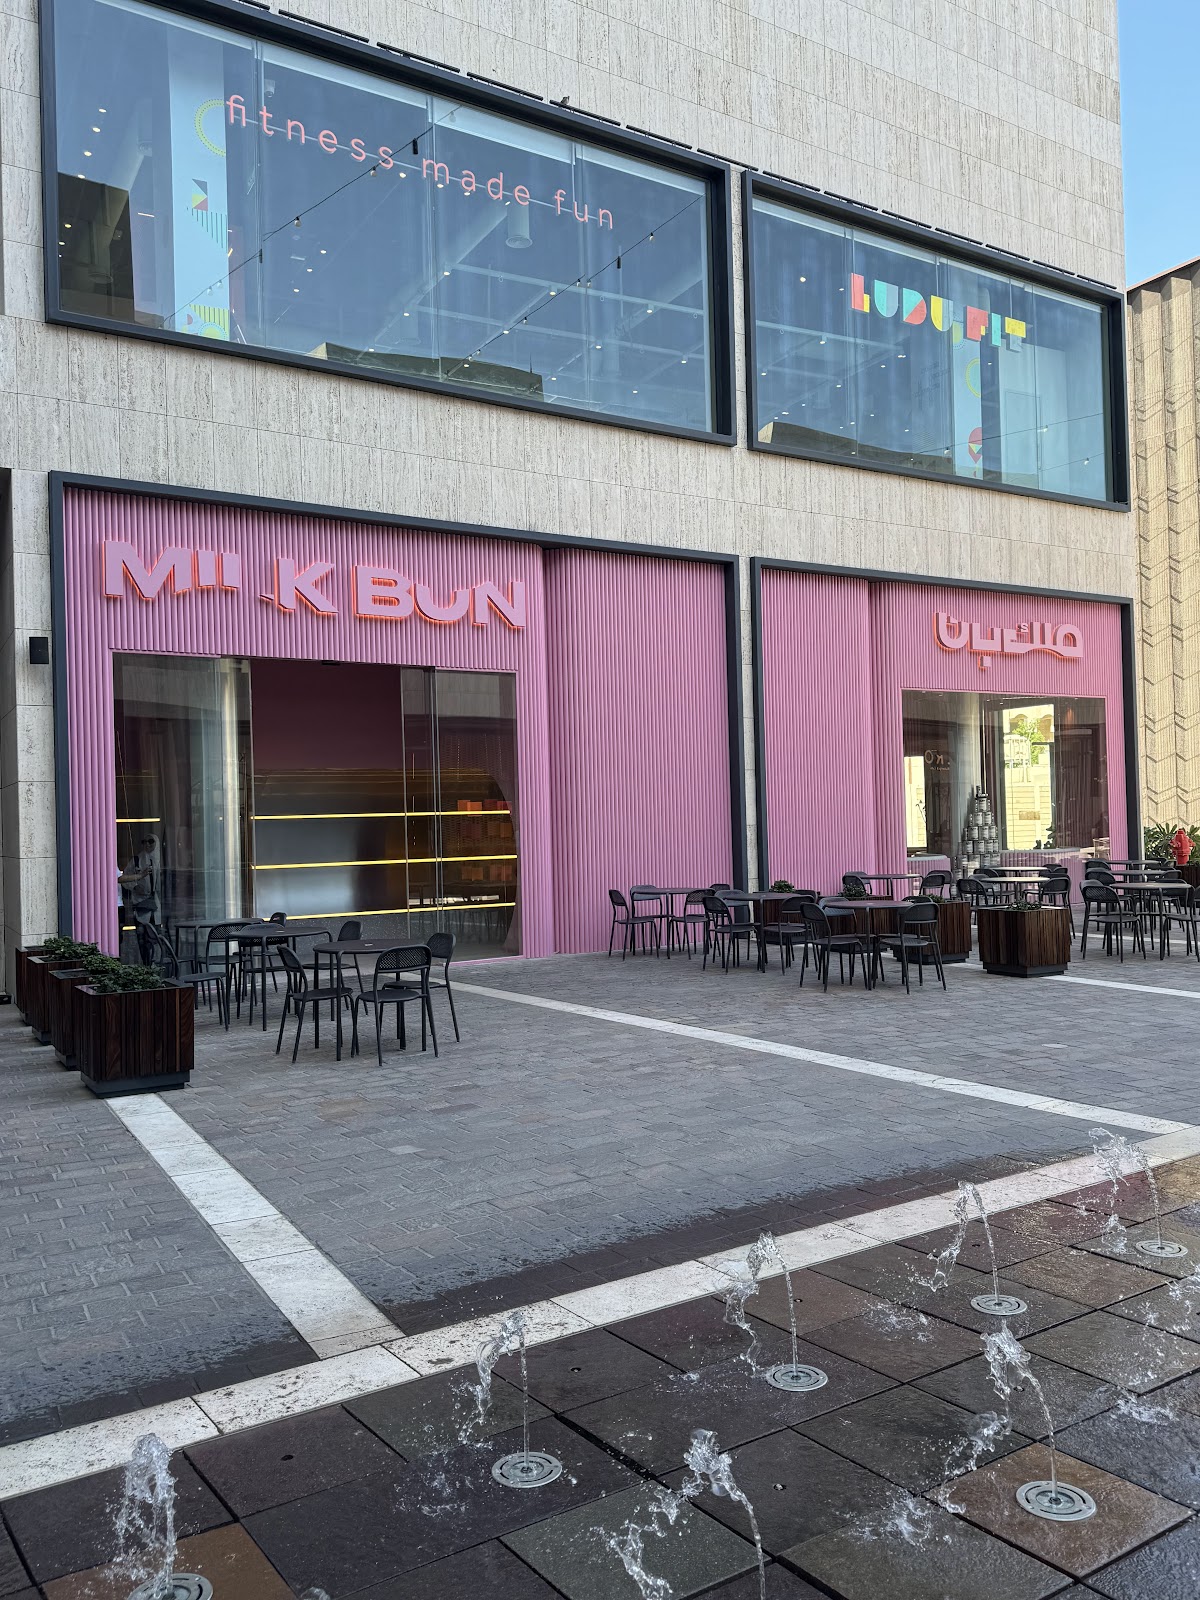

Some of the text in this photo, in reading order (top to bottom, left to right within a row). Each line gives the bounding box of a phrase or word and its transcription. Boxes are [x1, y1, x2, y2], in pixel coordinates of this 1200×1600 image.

[226, 93, 615, 231] fitness made fun
[103, 539, 527, 629] MILK BUN
